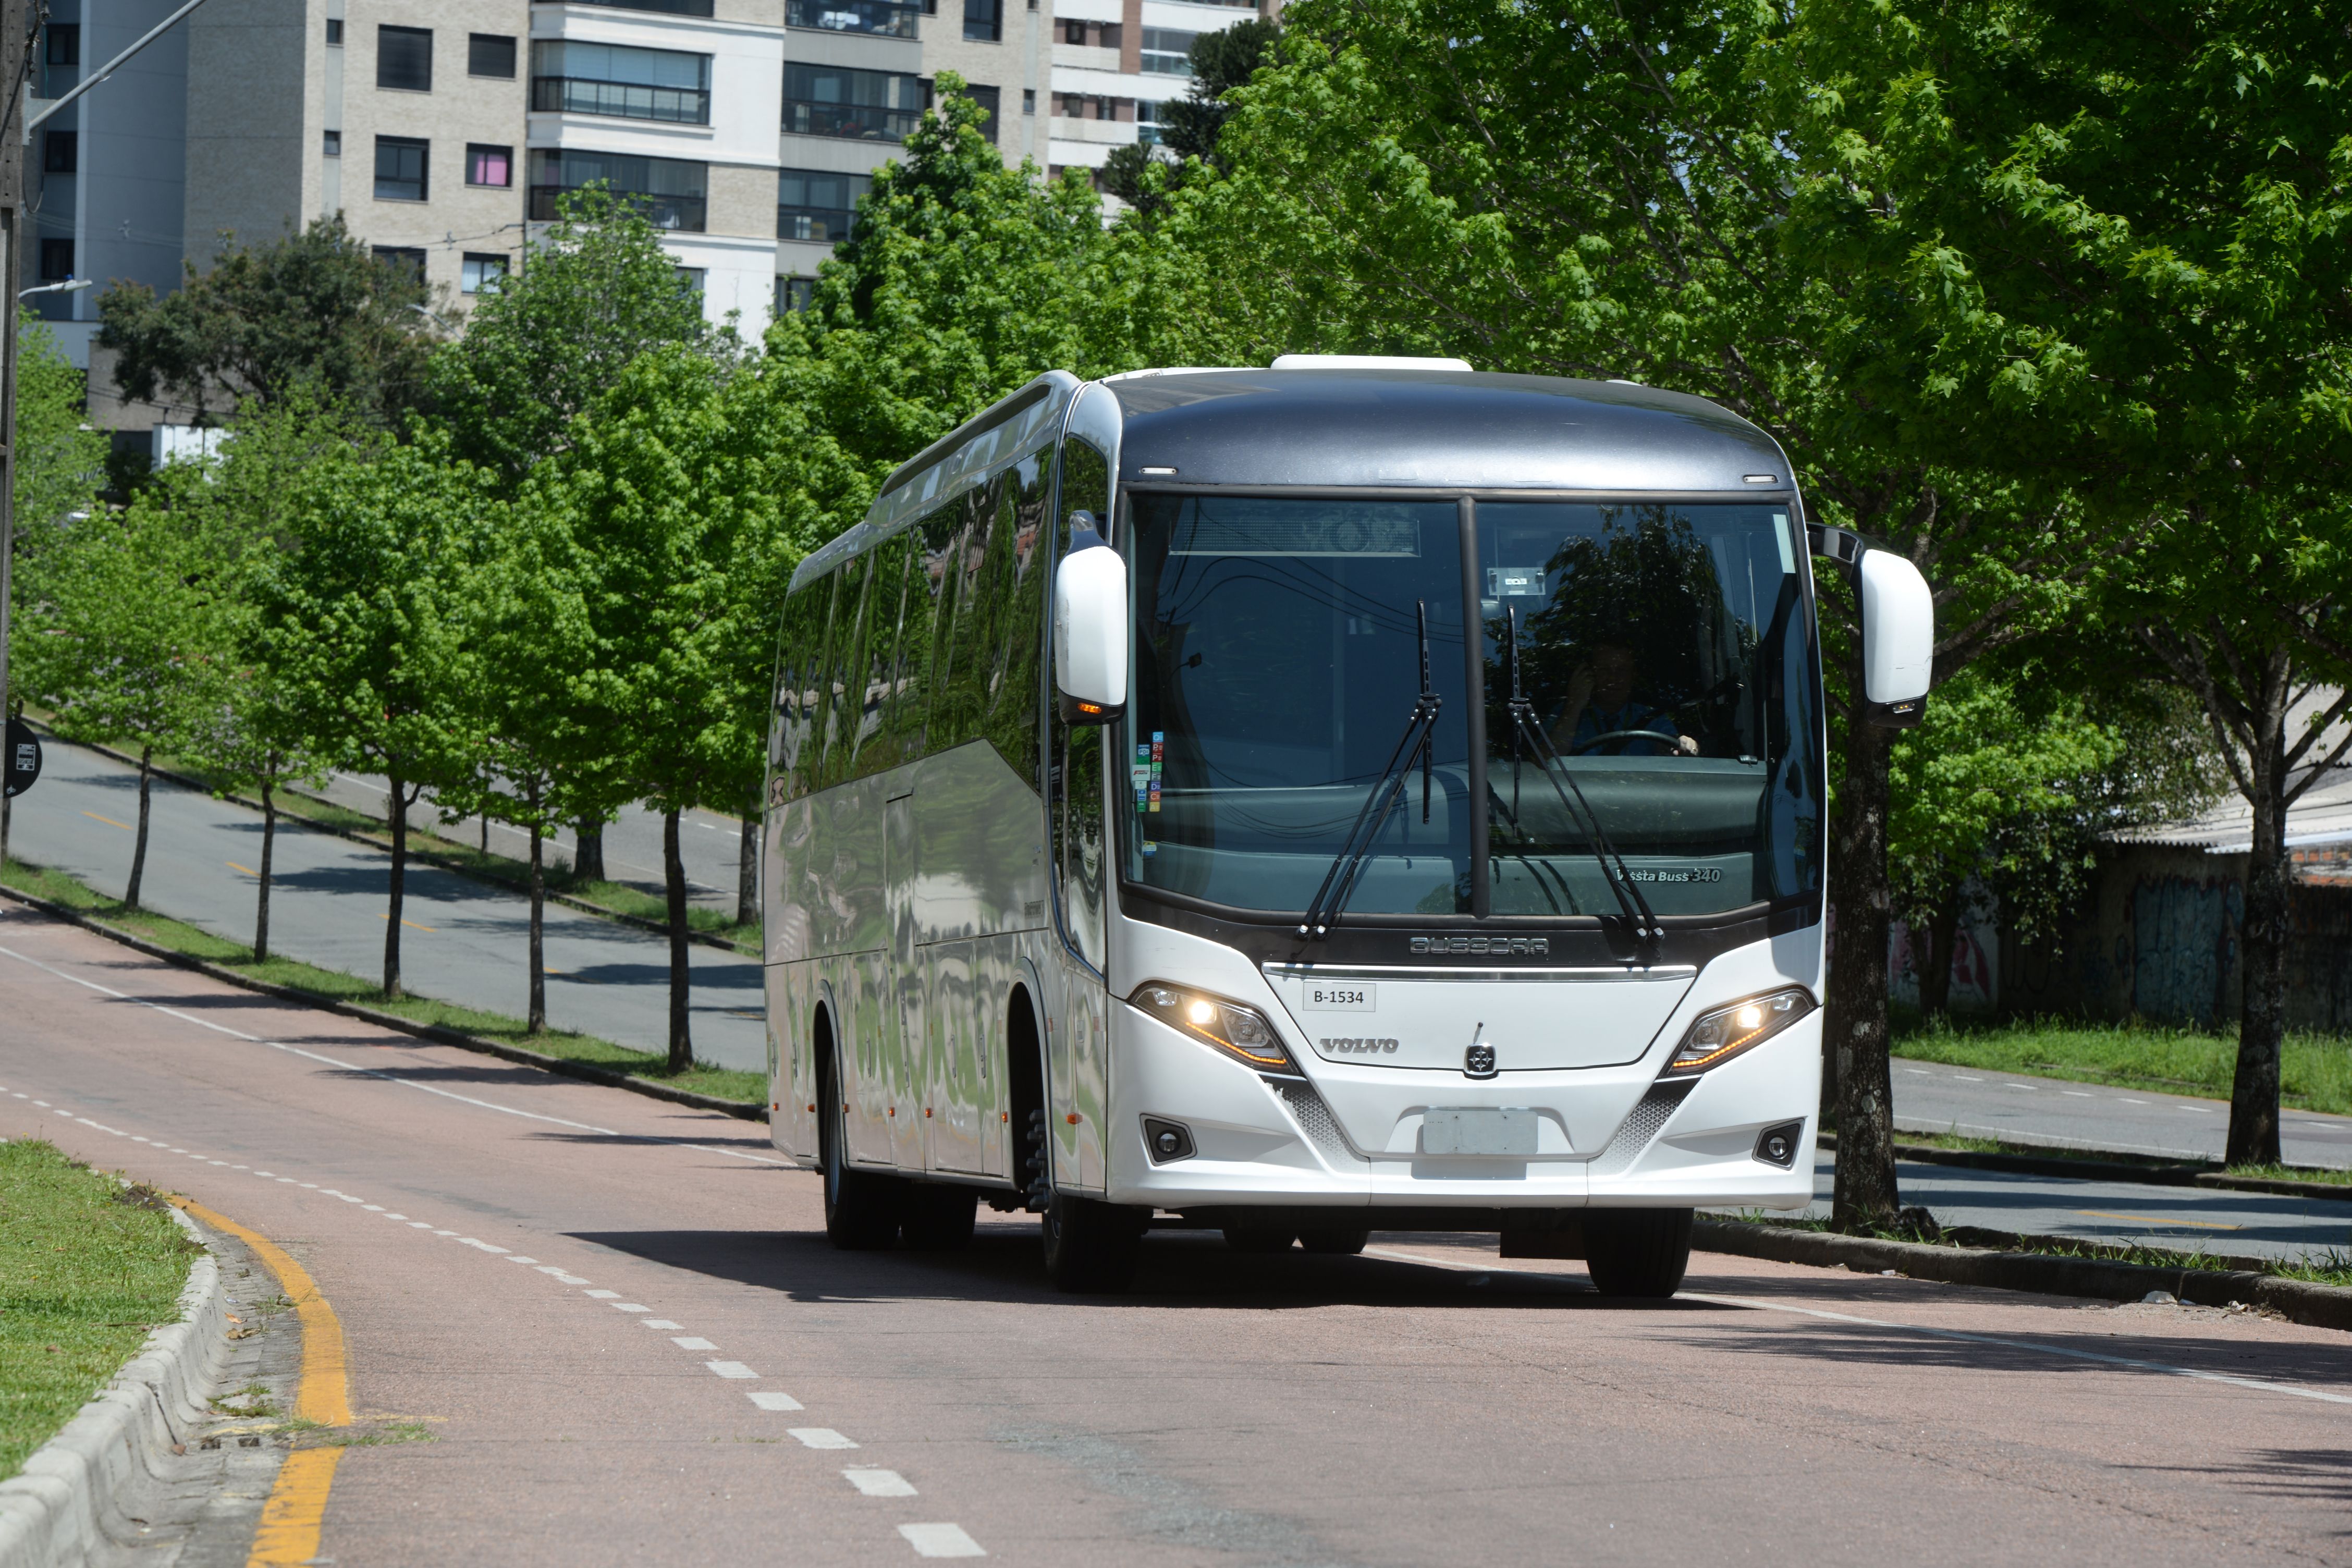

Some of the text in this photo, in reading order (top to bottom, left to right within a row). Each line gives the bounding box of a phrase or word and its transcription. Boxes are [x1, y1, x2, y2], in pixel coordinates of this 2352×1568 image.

[1616, 869, 1720, 882] Vssta Buss 340
[1410, 937, 1549, 954] BUSSCAR
[1314, 991, 1364, 1003] B-1534
[1319, 1038, 1399, 1054] VOLVO
